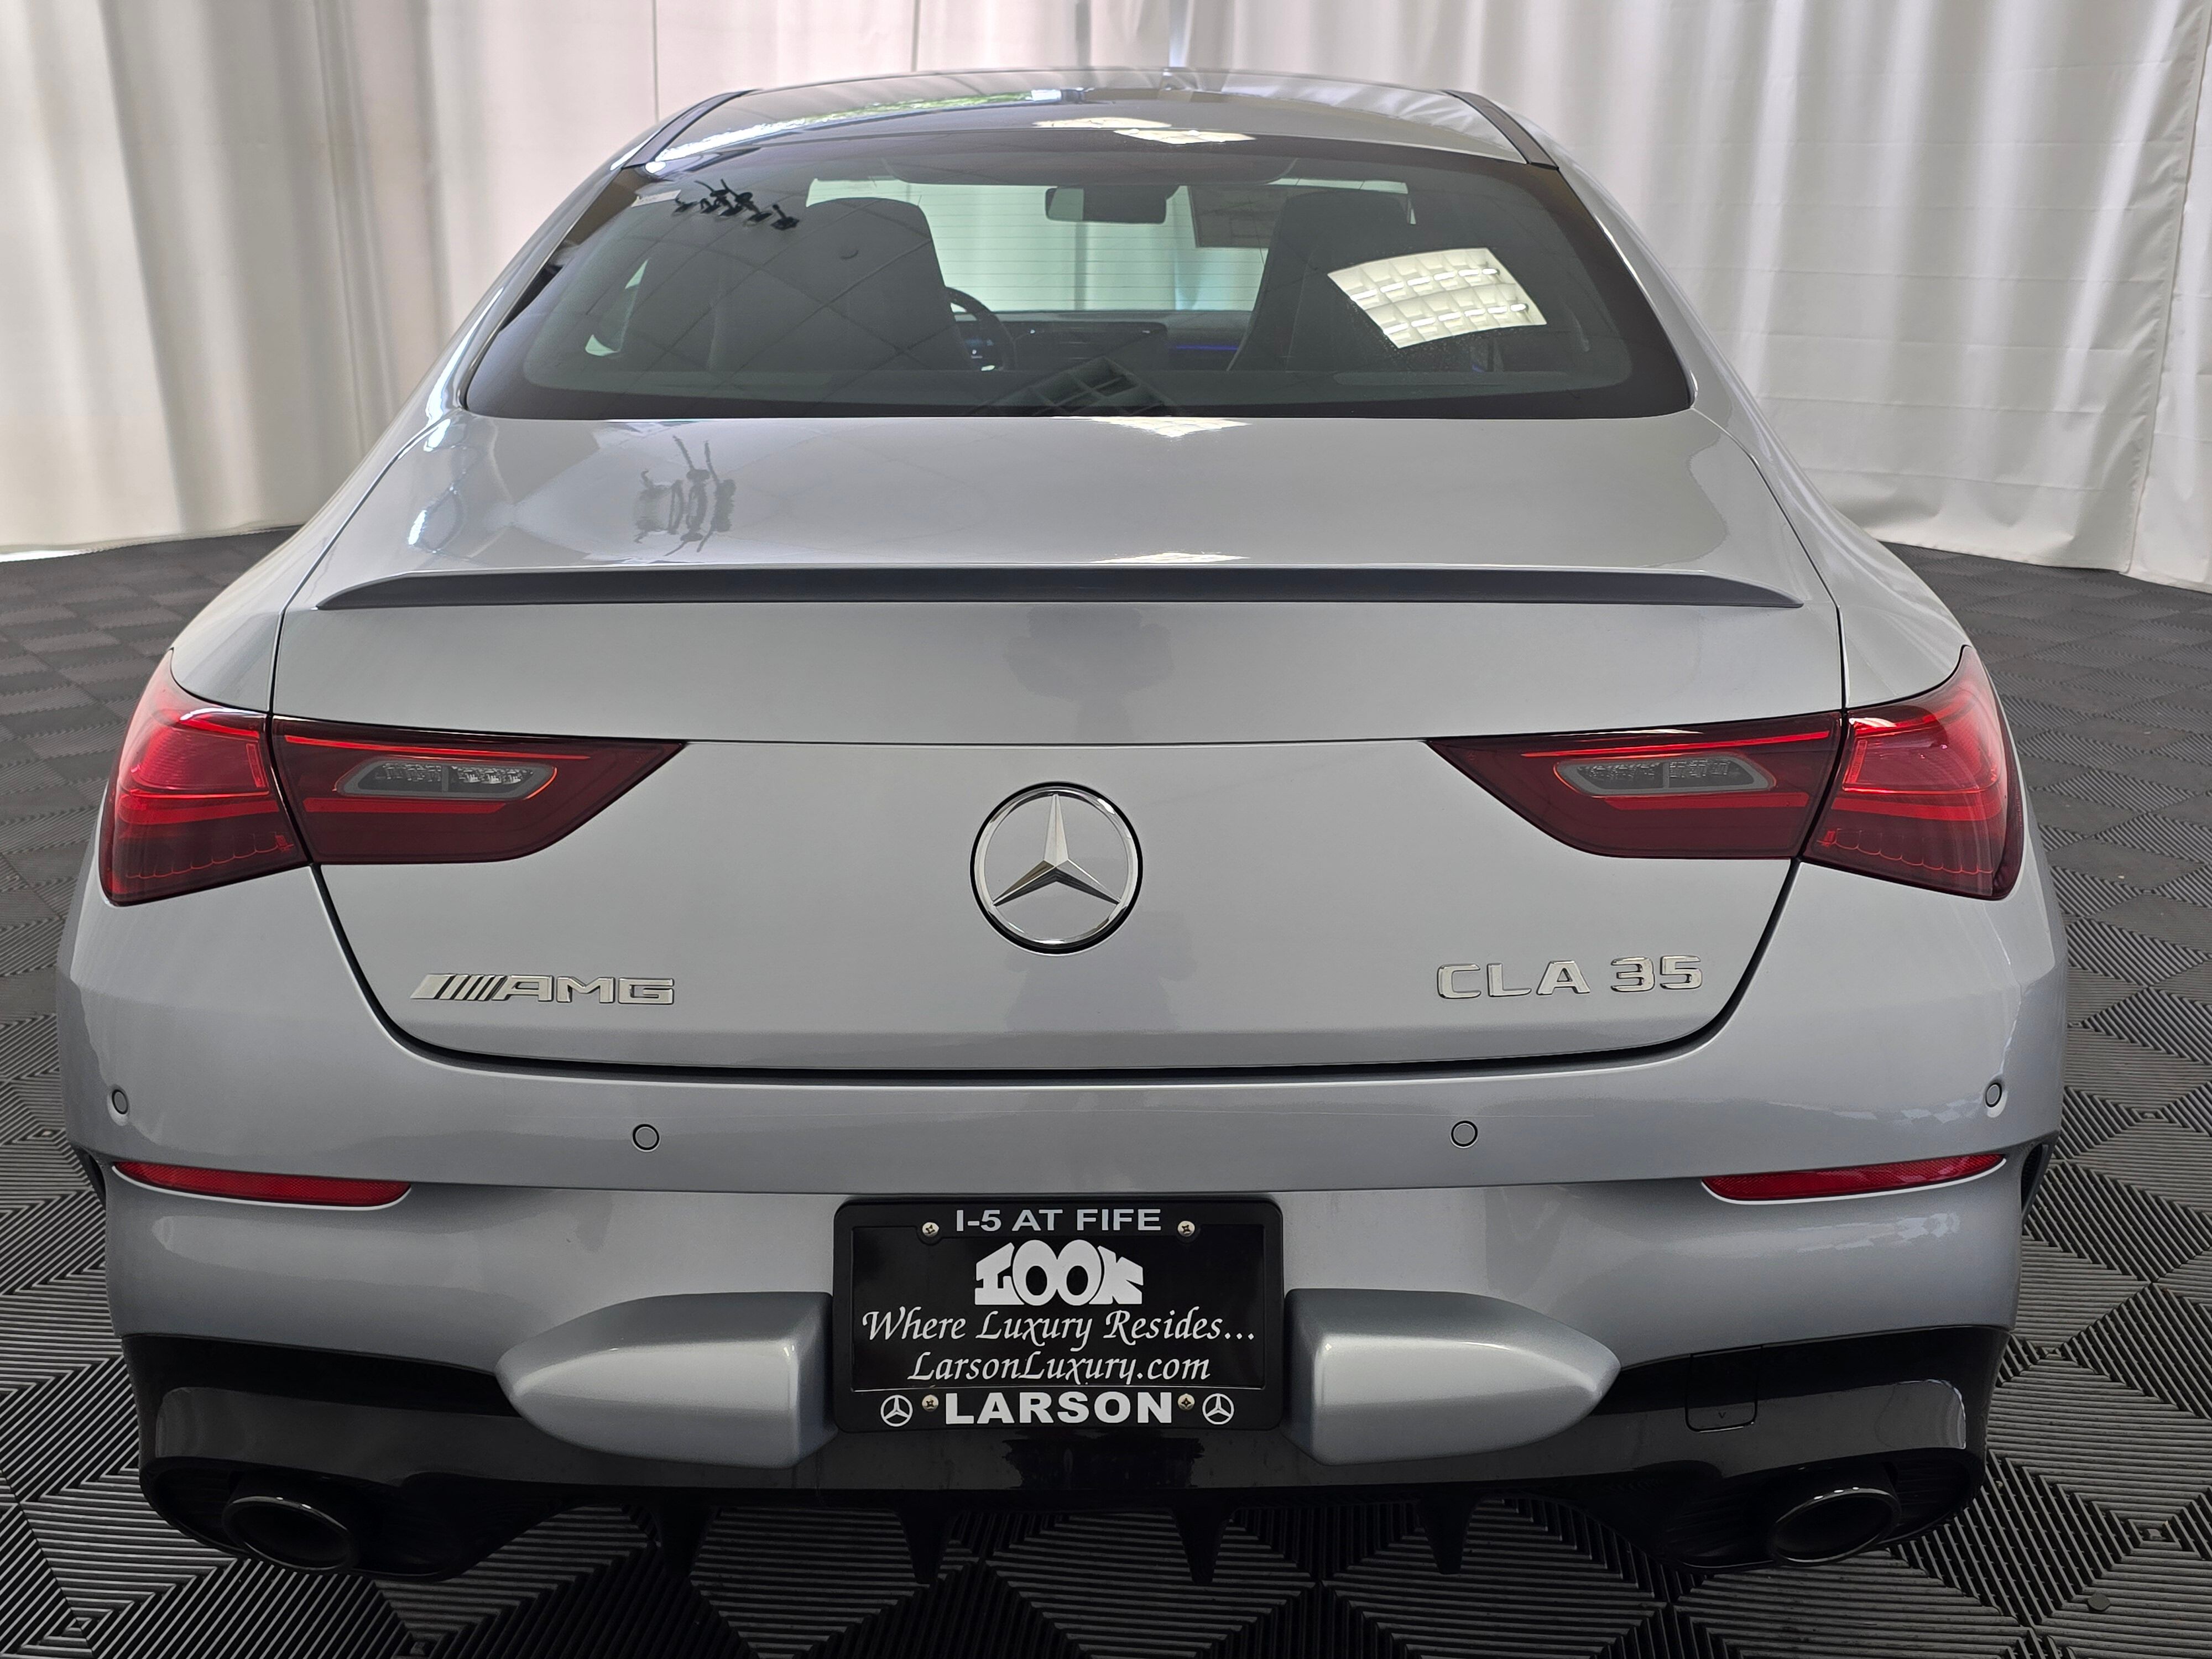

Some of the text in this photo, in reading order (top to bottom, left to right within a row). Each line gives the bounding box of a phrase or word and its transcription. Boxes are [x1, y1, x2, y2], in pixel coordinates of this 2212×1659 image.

[492, 975, 675, 1005] AMG
[1437, 955, 1703, 999] CLA 35
[956, 1209, 1162, 1232] I-5 AT FIFE
[974, 1239, 1144, 1306] LOOK
[862, 1306, 1255, 1352] Where Luxury Resides...
[907, 1351, 1211, 1385] LarsonLuxury.com
[945, 1391, 1172, 1425] LARSON
